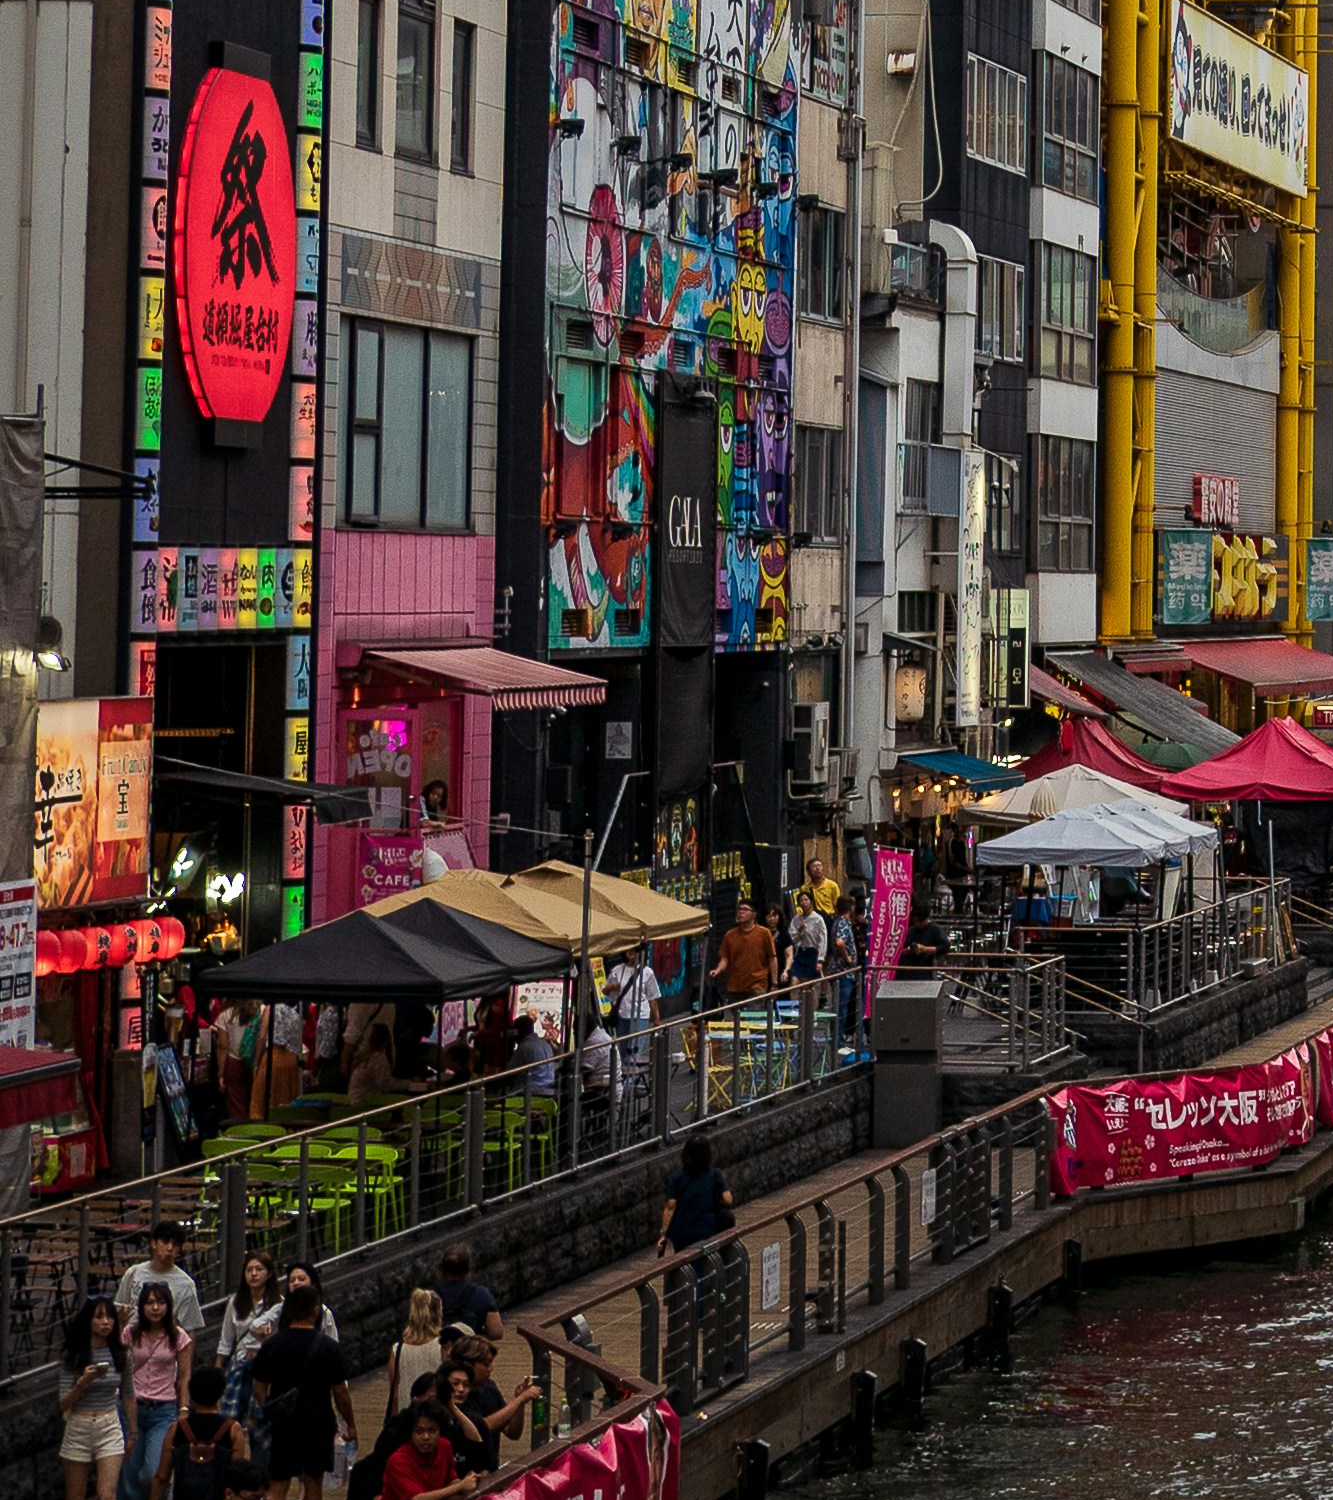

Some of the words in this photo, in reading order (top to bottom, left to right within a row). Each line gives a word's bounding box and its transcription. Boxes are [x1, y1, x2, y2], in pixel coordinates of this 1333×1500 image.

[212, 99, 280, 290] 祭
[669, 495, 703, 548] GALA
[1168, 542, 1207, 580] 薬
[261, 563, 275, 589] 肉
[1167, 583, 1207, 592] Medicine
[122, 754, 147, 776] Candy
[116, 779, 130, 815] 宝
[374, 874, 410, 887] CAFE
[879, 899, 888, 920] OPEN
